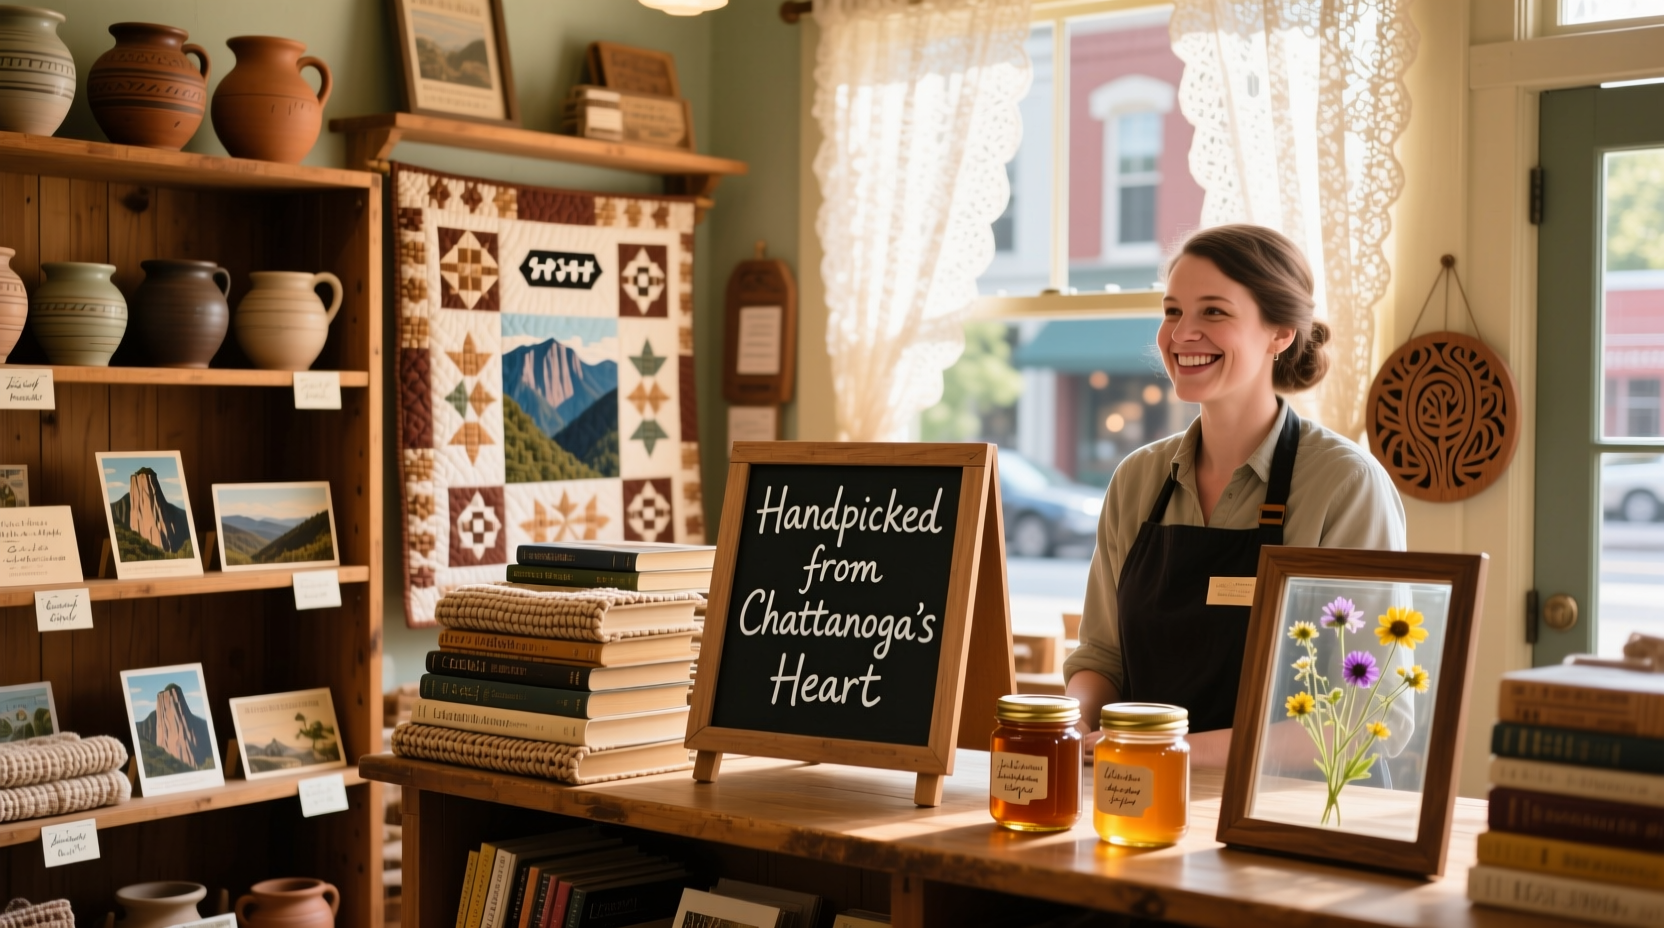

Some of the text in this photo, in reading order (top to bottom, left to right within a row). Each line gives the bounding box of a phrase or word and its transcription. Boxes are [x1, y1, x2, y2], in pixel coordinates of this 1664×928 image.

[756, 485, 943, 548] Handpicked
[798, 543, 883, 594] from
[739, 588, 936, 660] Chattanoga's
[770, 652, 882, 708] Heart
